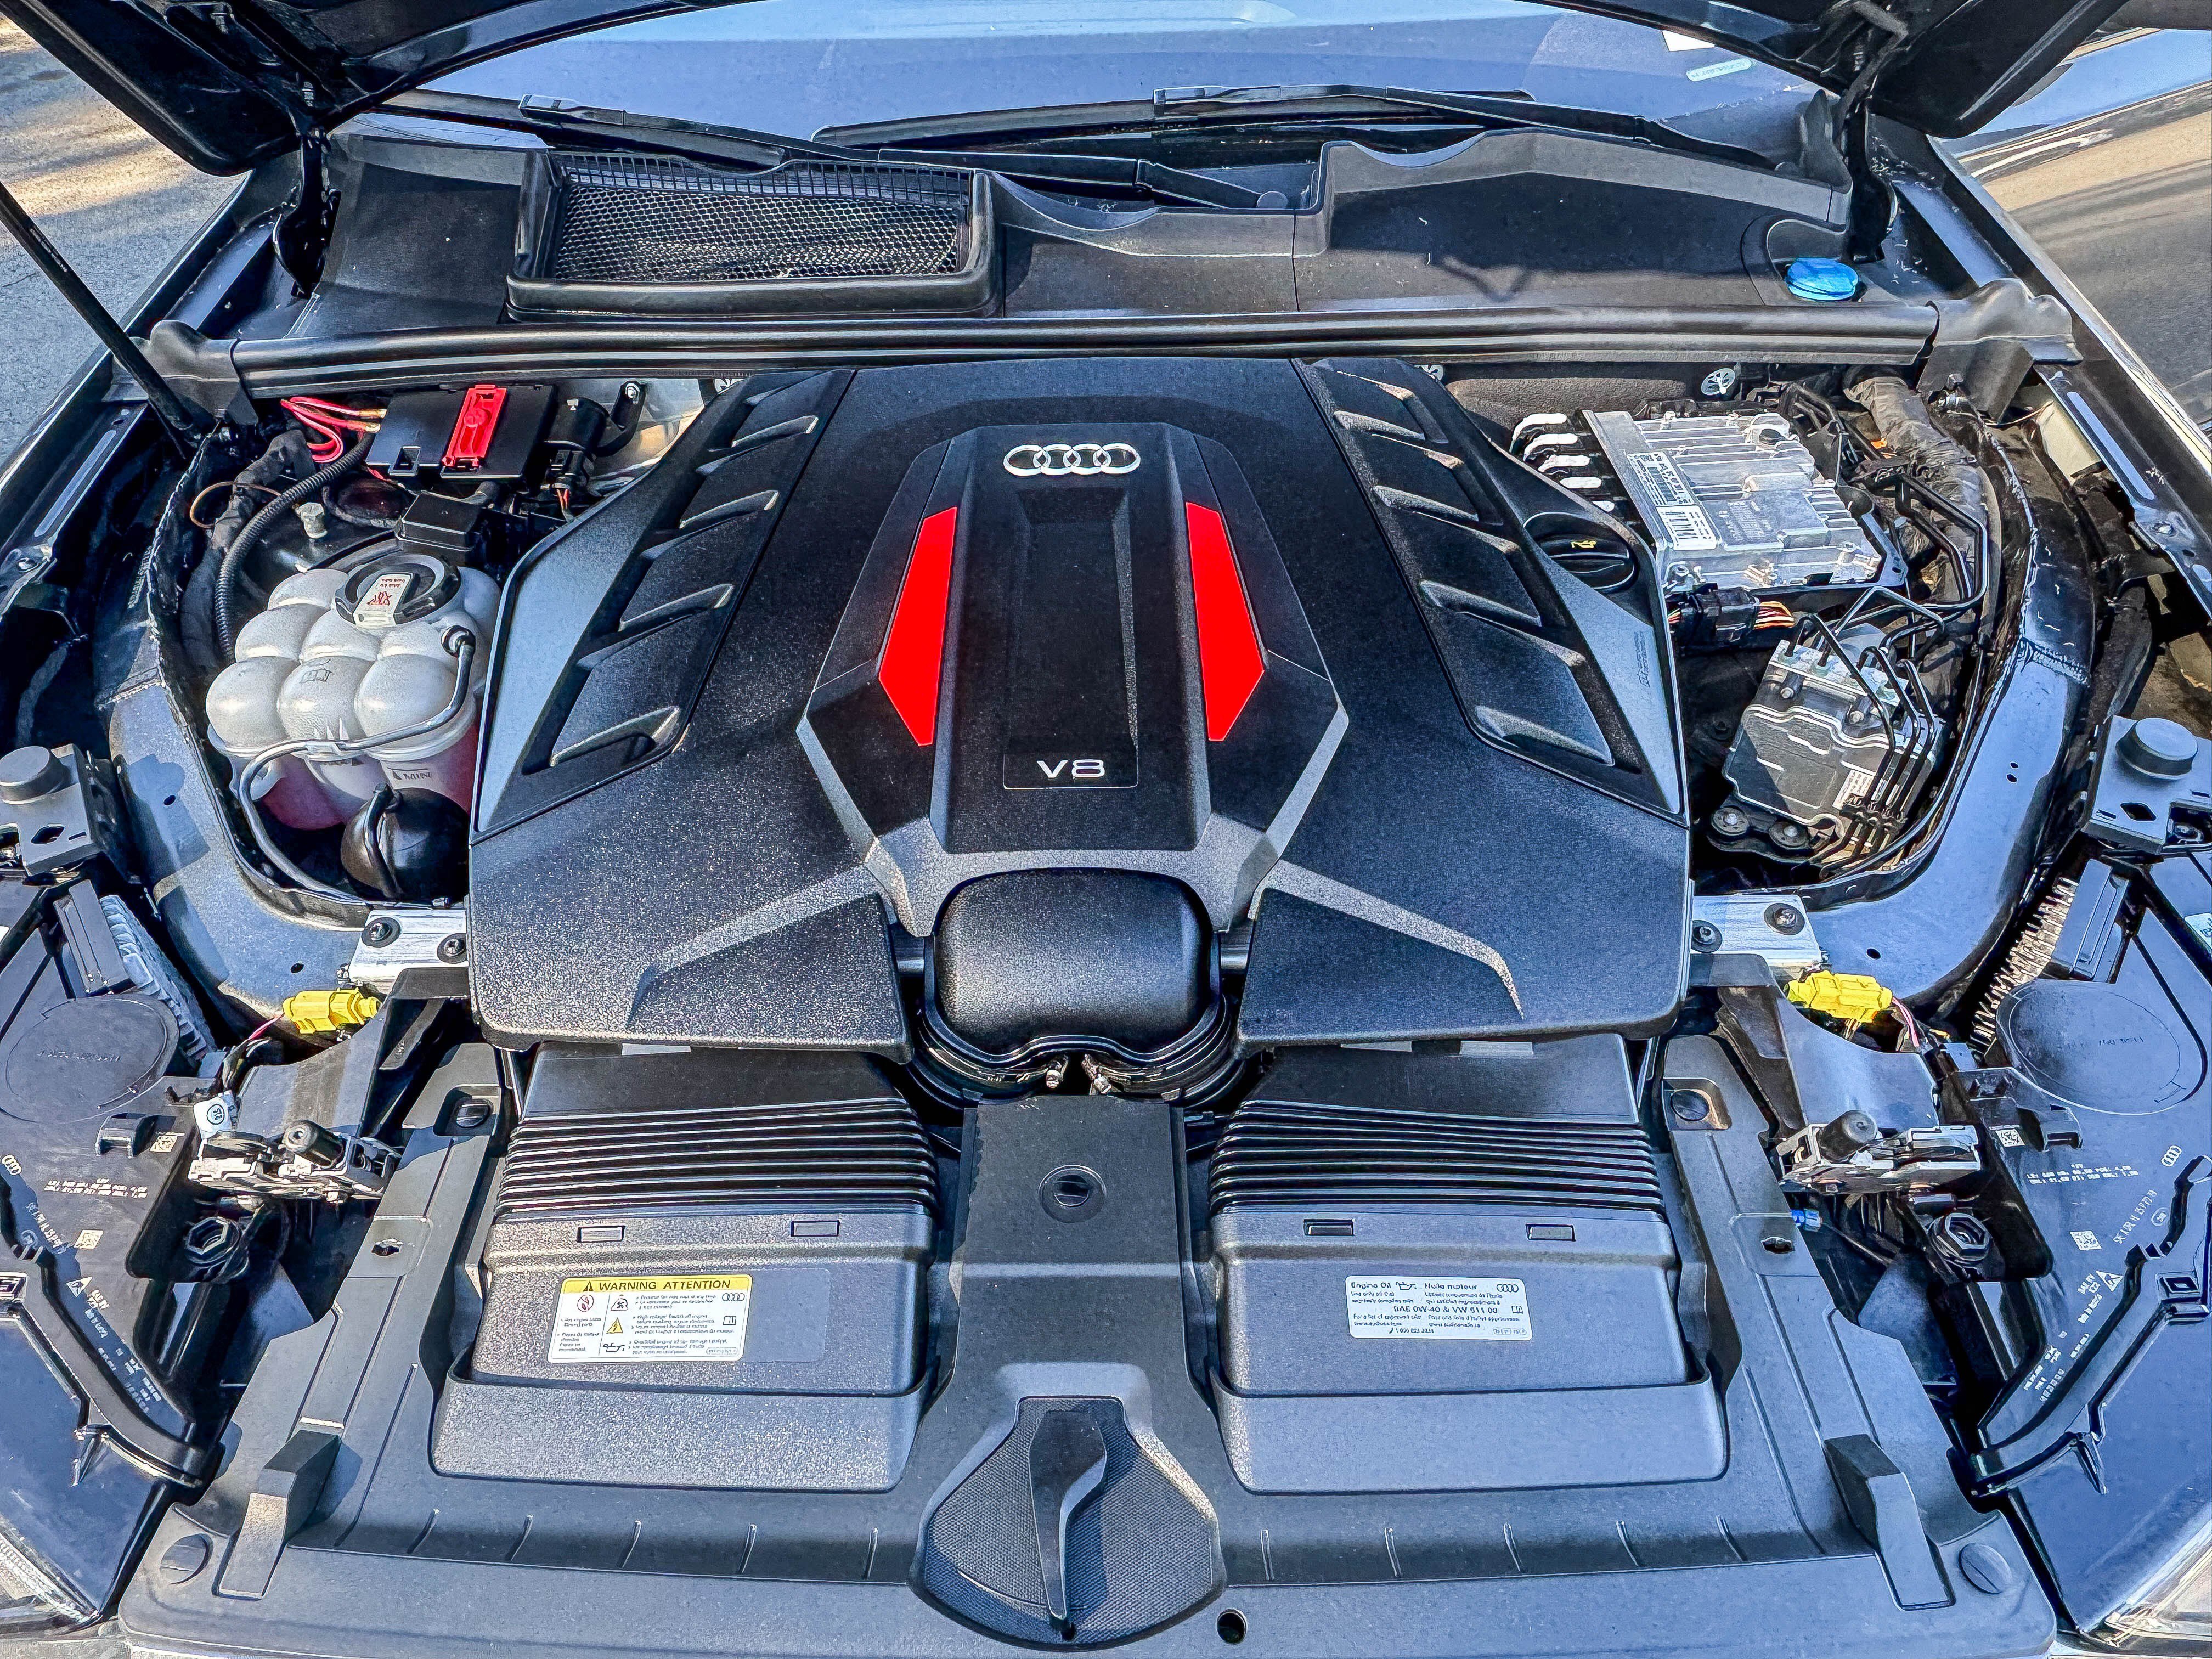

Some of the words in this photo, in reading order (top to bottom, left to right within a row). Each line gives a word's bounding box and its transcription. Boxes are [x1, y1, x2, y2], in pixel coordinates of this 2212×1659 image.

[1036, 759, 1105, 778] V8
[599, 1281, 656, 1291] WARNING
[663, 1279, 731, 1290] ATTENTION
[1351, 1282, 1378, 1290] Engine
